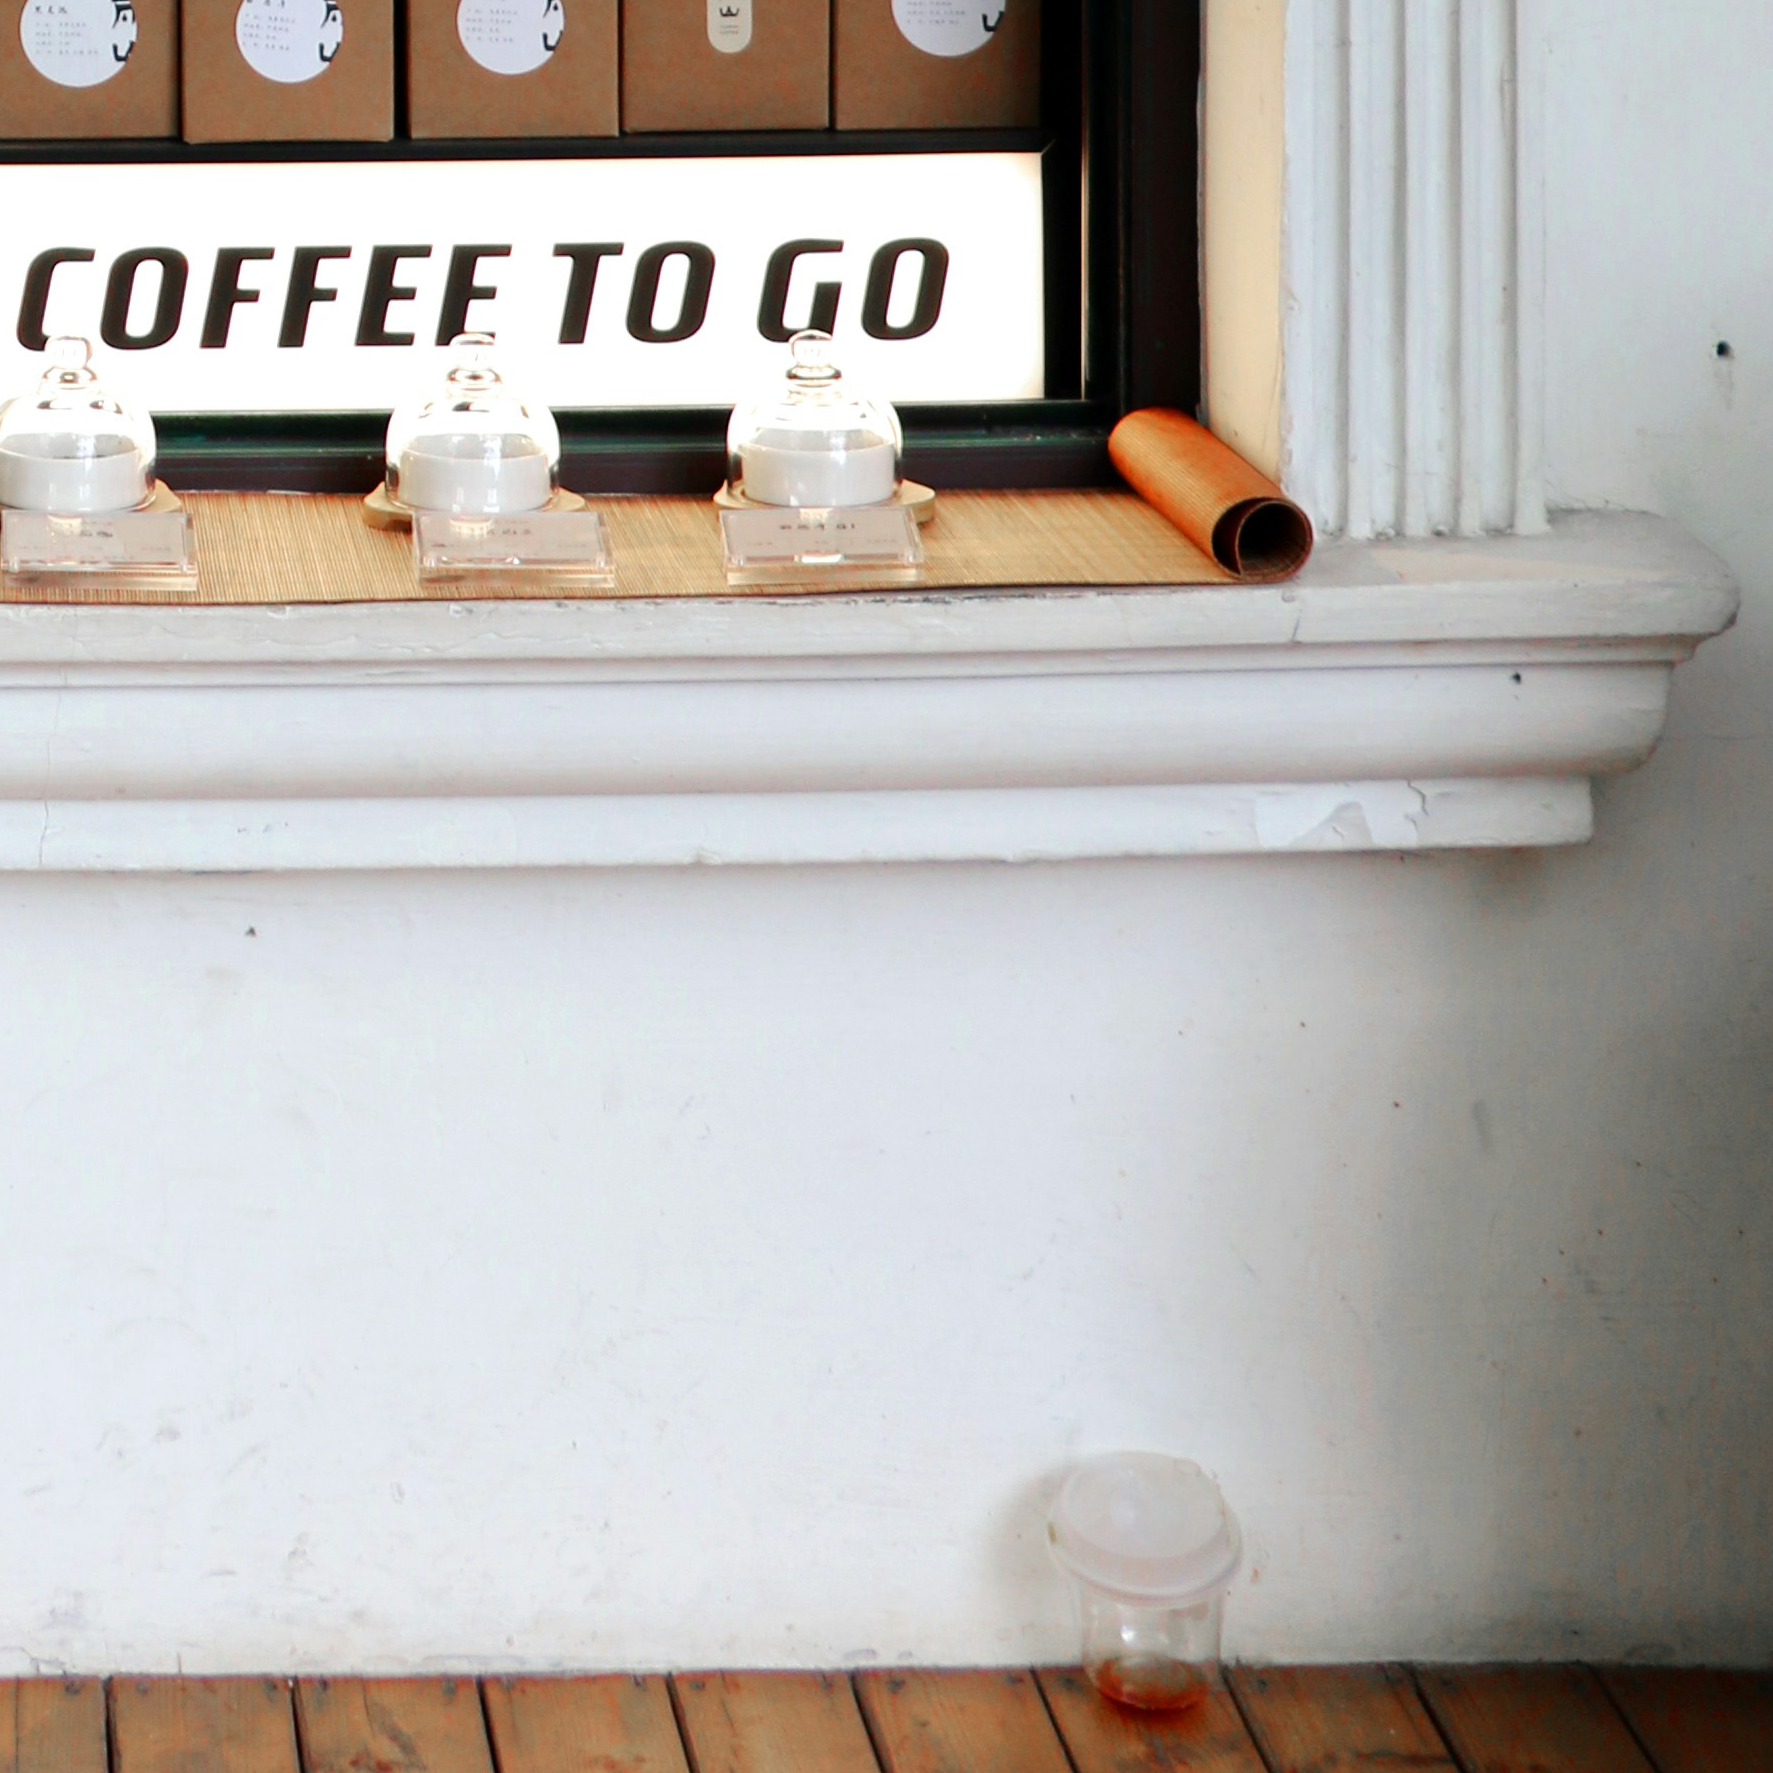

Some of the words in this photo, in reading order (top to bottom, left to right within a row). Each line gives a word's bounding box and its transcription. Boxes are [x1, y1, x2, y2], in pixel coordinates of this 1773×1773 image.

[16, 244, 512, 352] COFFEE
[551, 240, 717, 344] TO
[756, 236, 951, 344] GO
